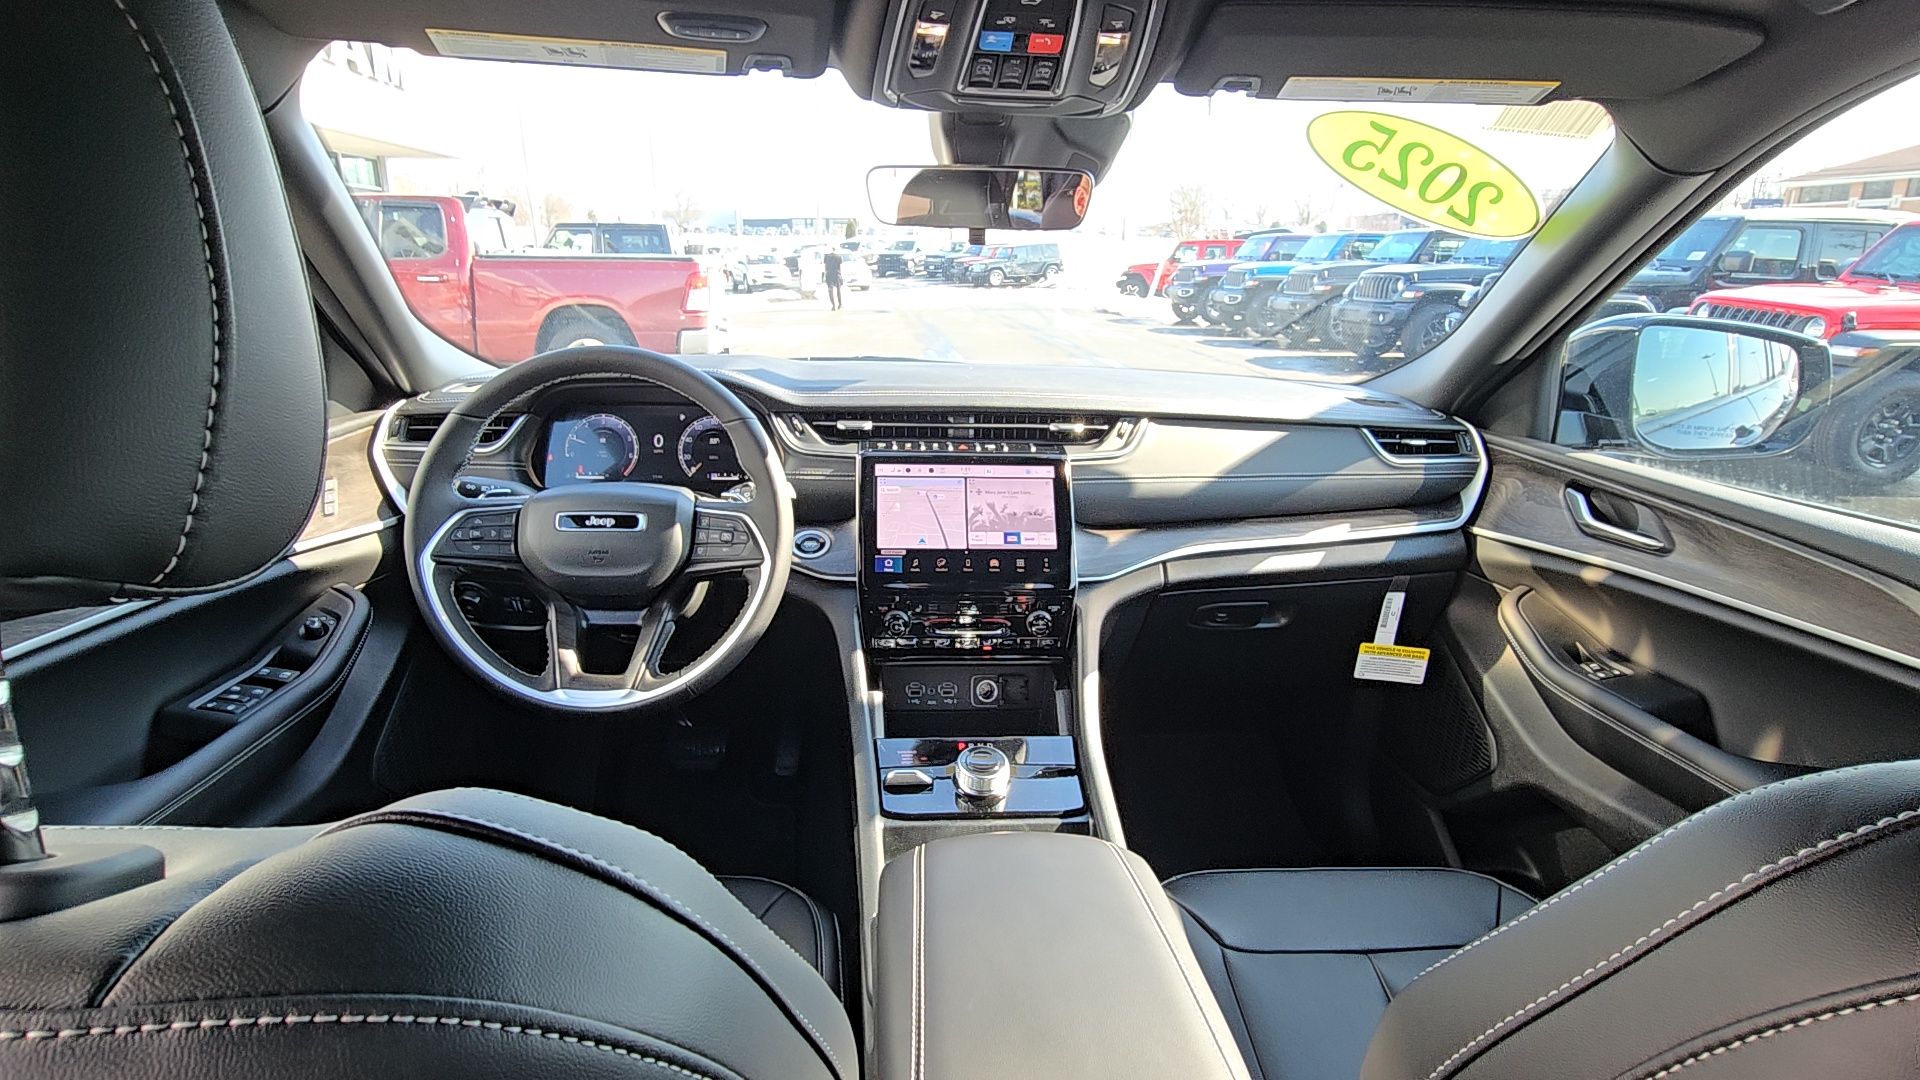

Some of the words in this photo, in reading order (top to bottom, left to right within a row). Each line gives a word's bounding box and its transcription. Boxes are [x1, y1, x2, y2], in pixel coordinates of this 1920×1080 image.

[653, 433, 664, 448] 0
[585, 515, 616, 527] Jeep
[958, 742, 966, 750] P
